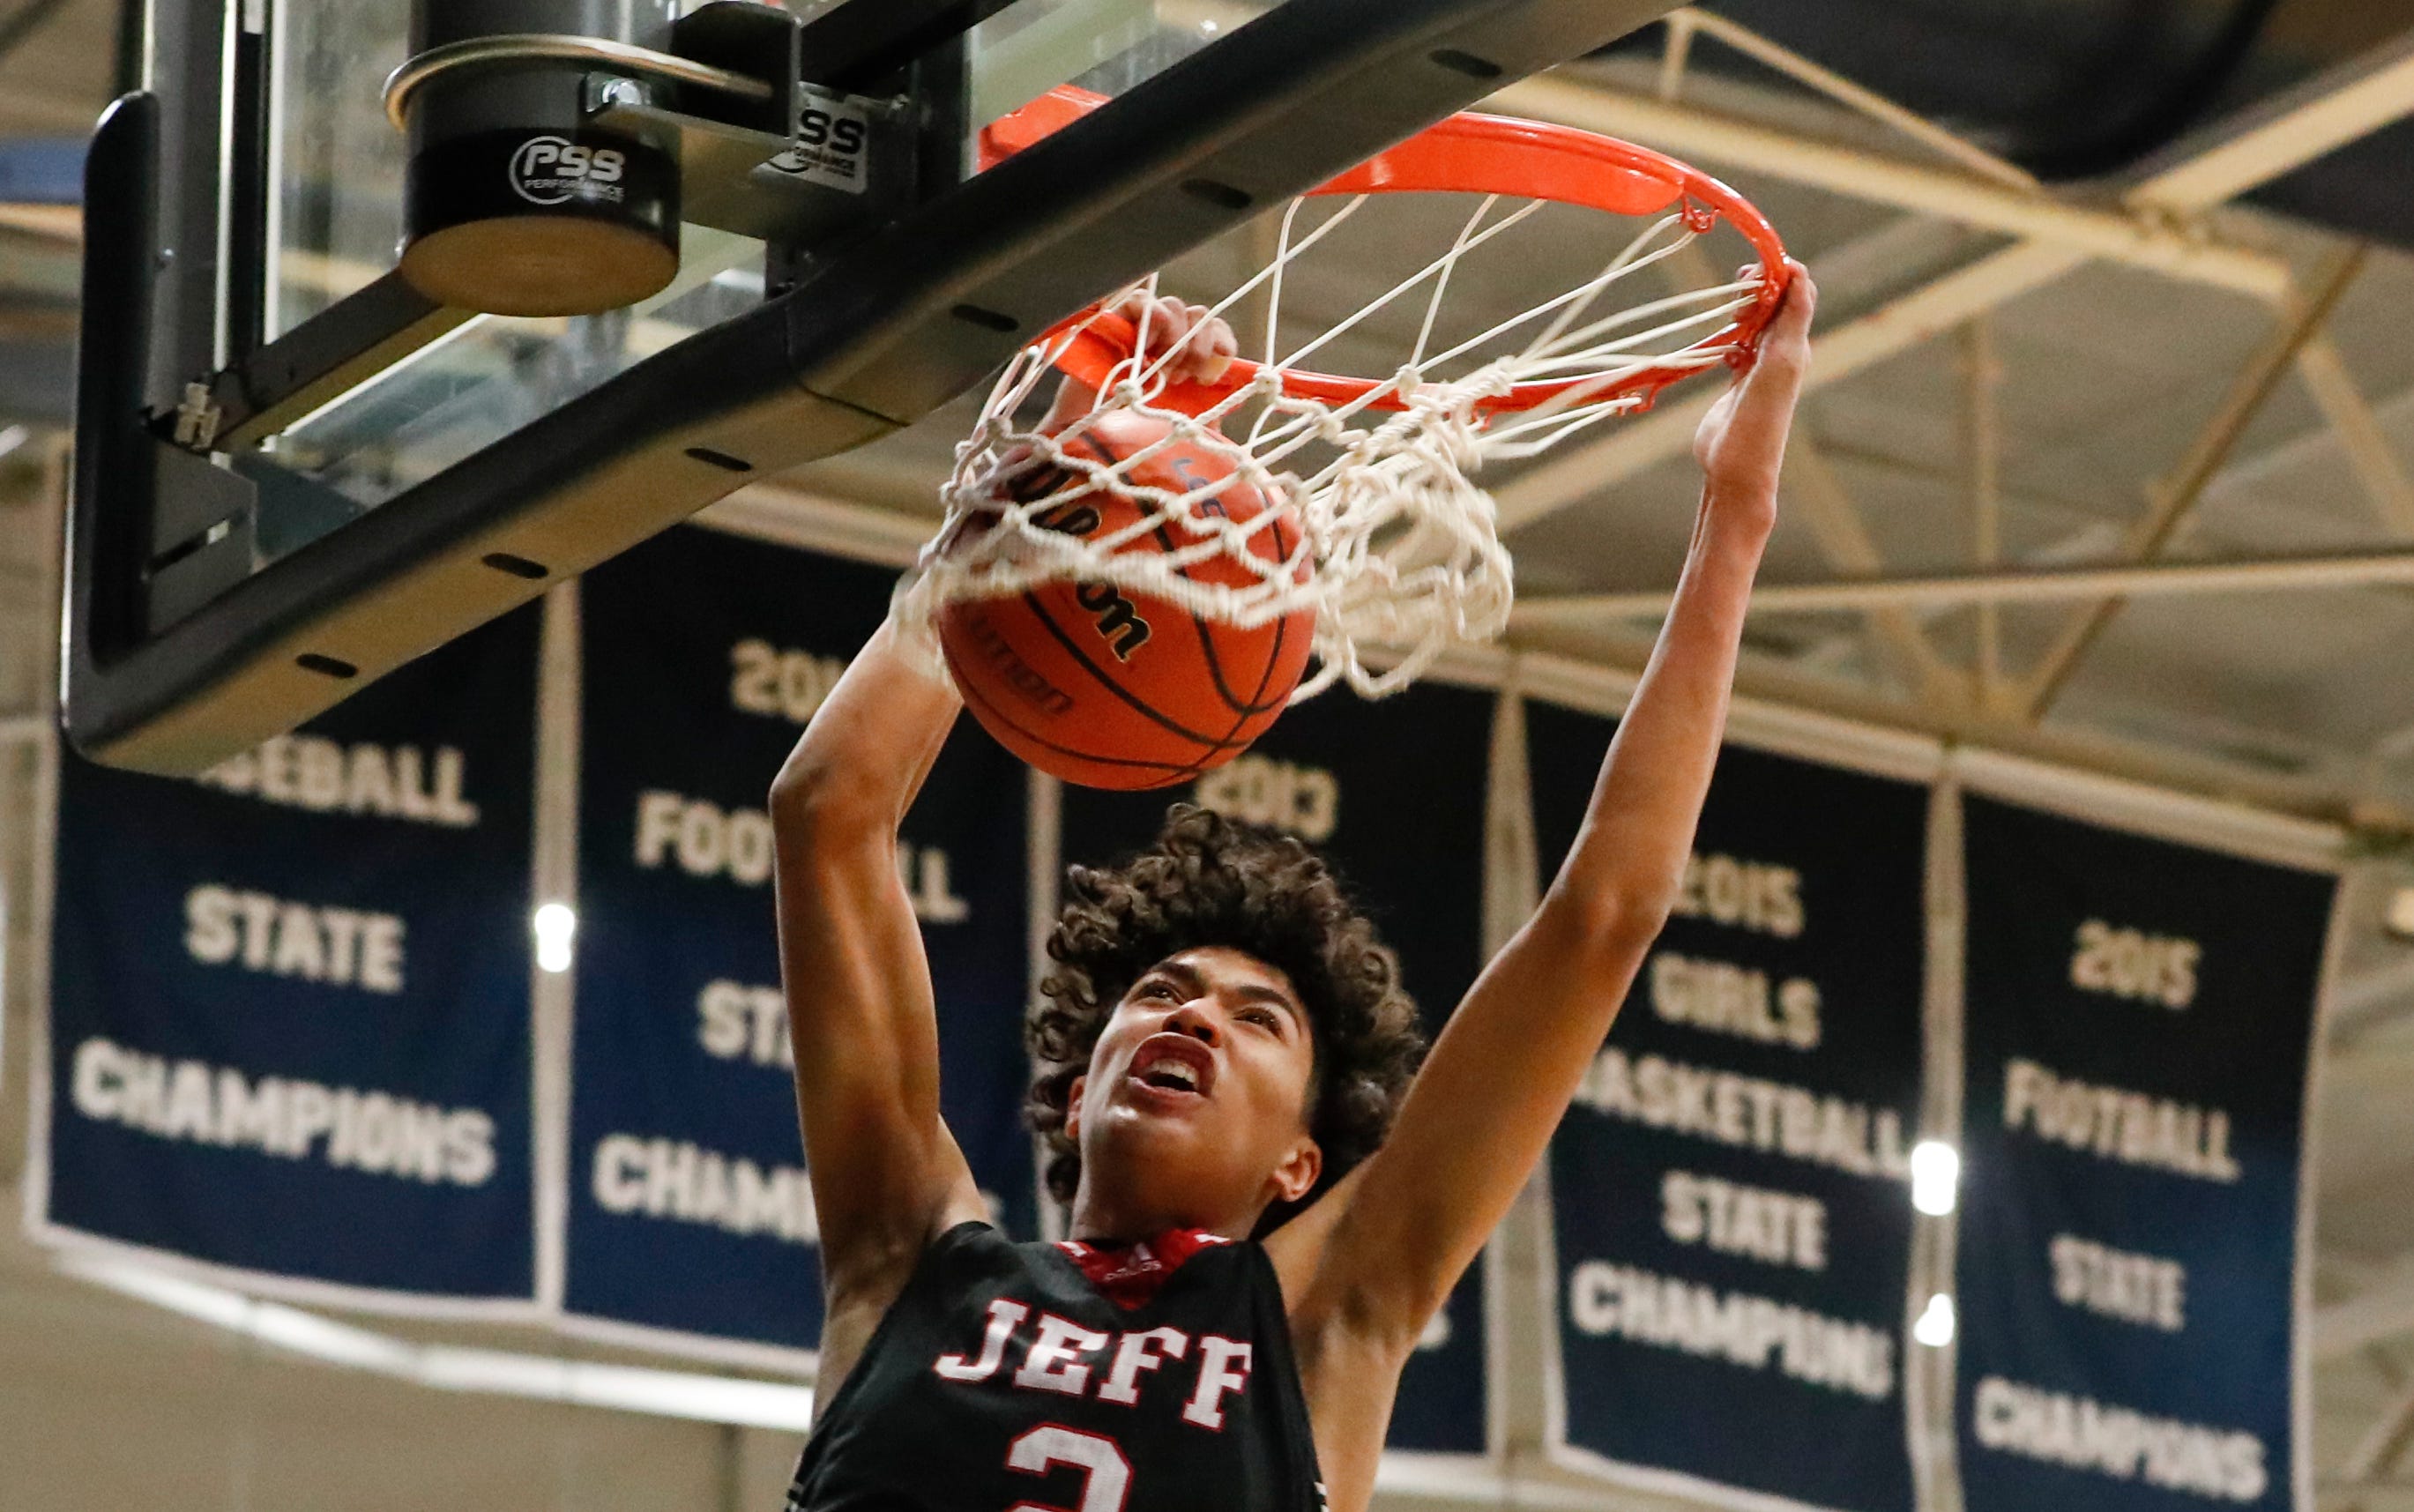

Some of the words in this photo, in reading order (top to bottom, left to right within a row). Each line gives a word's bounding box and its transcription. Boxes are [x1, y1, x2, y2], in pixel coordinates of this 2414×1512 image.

[523, 145, 625, 182] PSS
[798, 108, 865, 155] SS
[184, 884, 405, 994] STATE
[2068, 919, 2202, 1009] 2015
[1651, 952, 1822, 1049] GIRLS
[72, 1037, 496, 1187] CHAMPIONS
[1576, 1049, 1911, 1181] ASKETBALL
[2003, 1060, 2240, 1183] FOOTBALL
[1661, 1170, 1827, 1271] STATE
[1570, 1261, 1893, 1398] CHAMPIONS
[2050, 1236, 2186, 1331] STATE
[935, 1298, 1252, 1429] JEFF
[1974, 1377, 2267, 1501] CHAMPIONS
